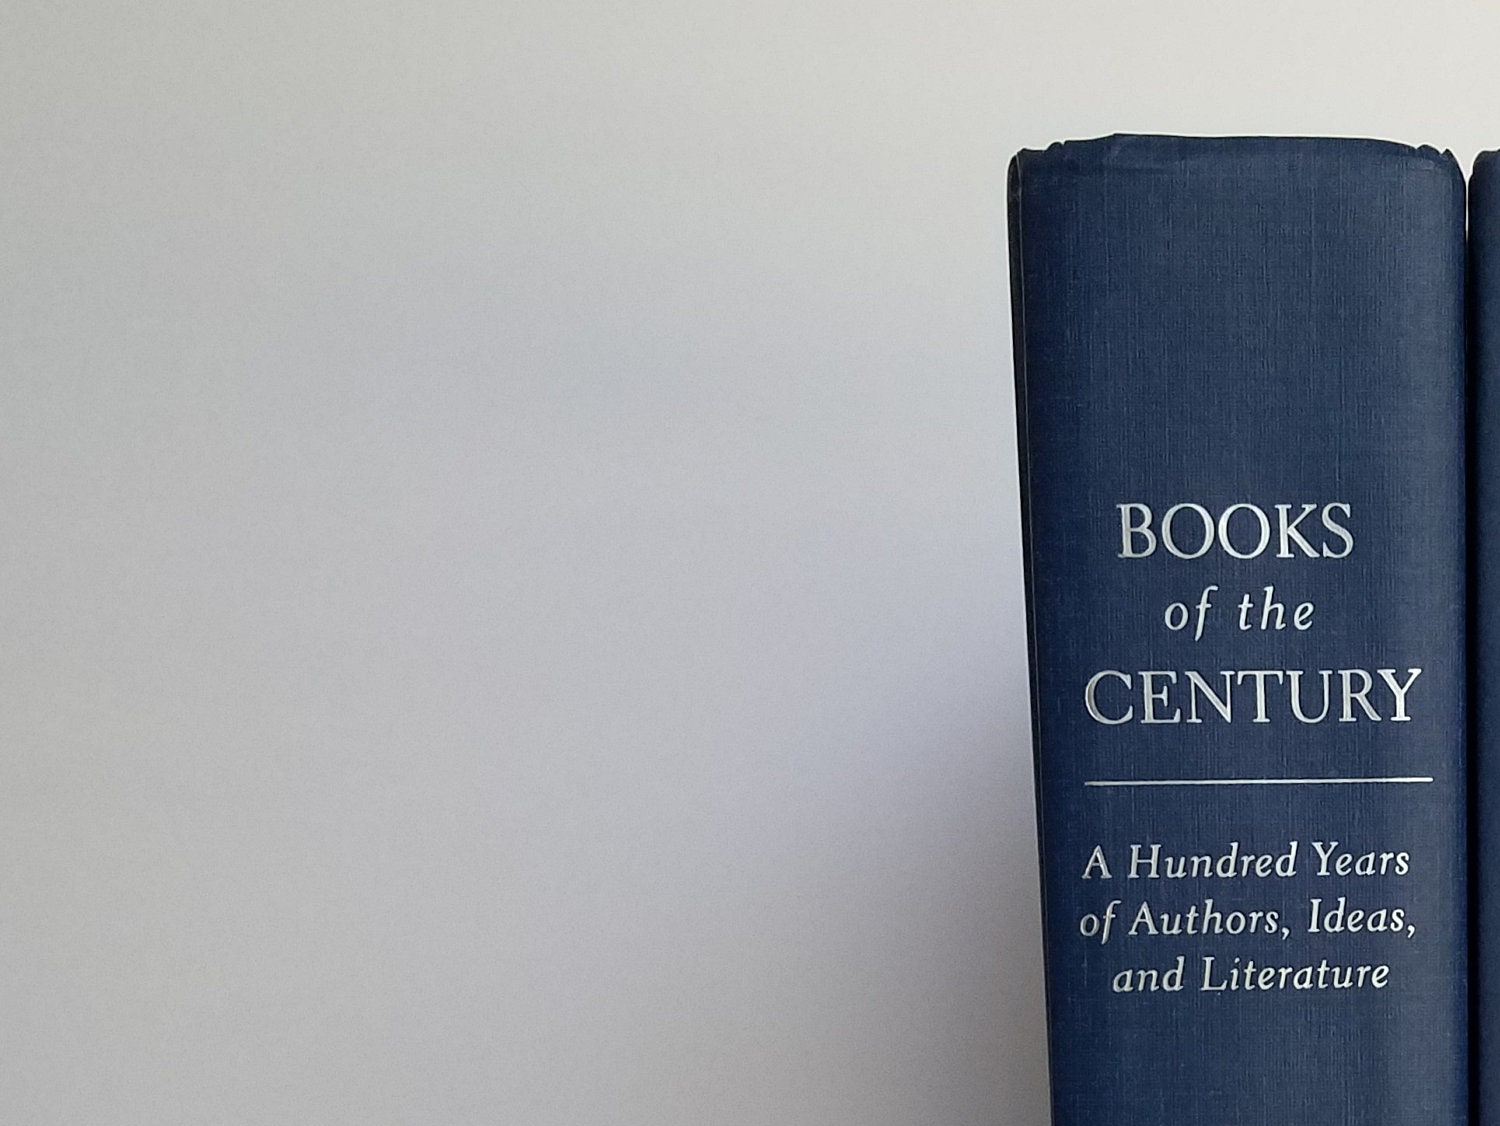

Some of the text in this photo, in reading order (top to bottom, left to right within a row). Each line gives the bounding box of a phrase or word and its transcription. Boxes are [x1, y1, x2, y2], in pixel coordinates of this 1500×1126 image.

[1117, 503, 1354, 558] BOOKS
[1165, 585, 1314, 640] of the
[1084, 667, 1422, 724] CENTURY
[1082, 841, 1410, 879] A Hundred Years
[1080, 898, 1416, 944] of Authors, Ideas,
[1113, 956, 1390, 993] and Literature
